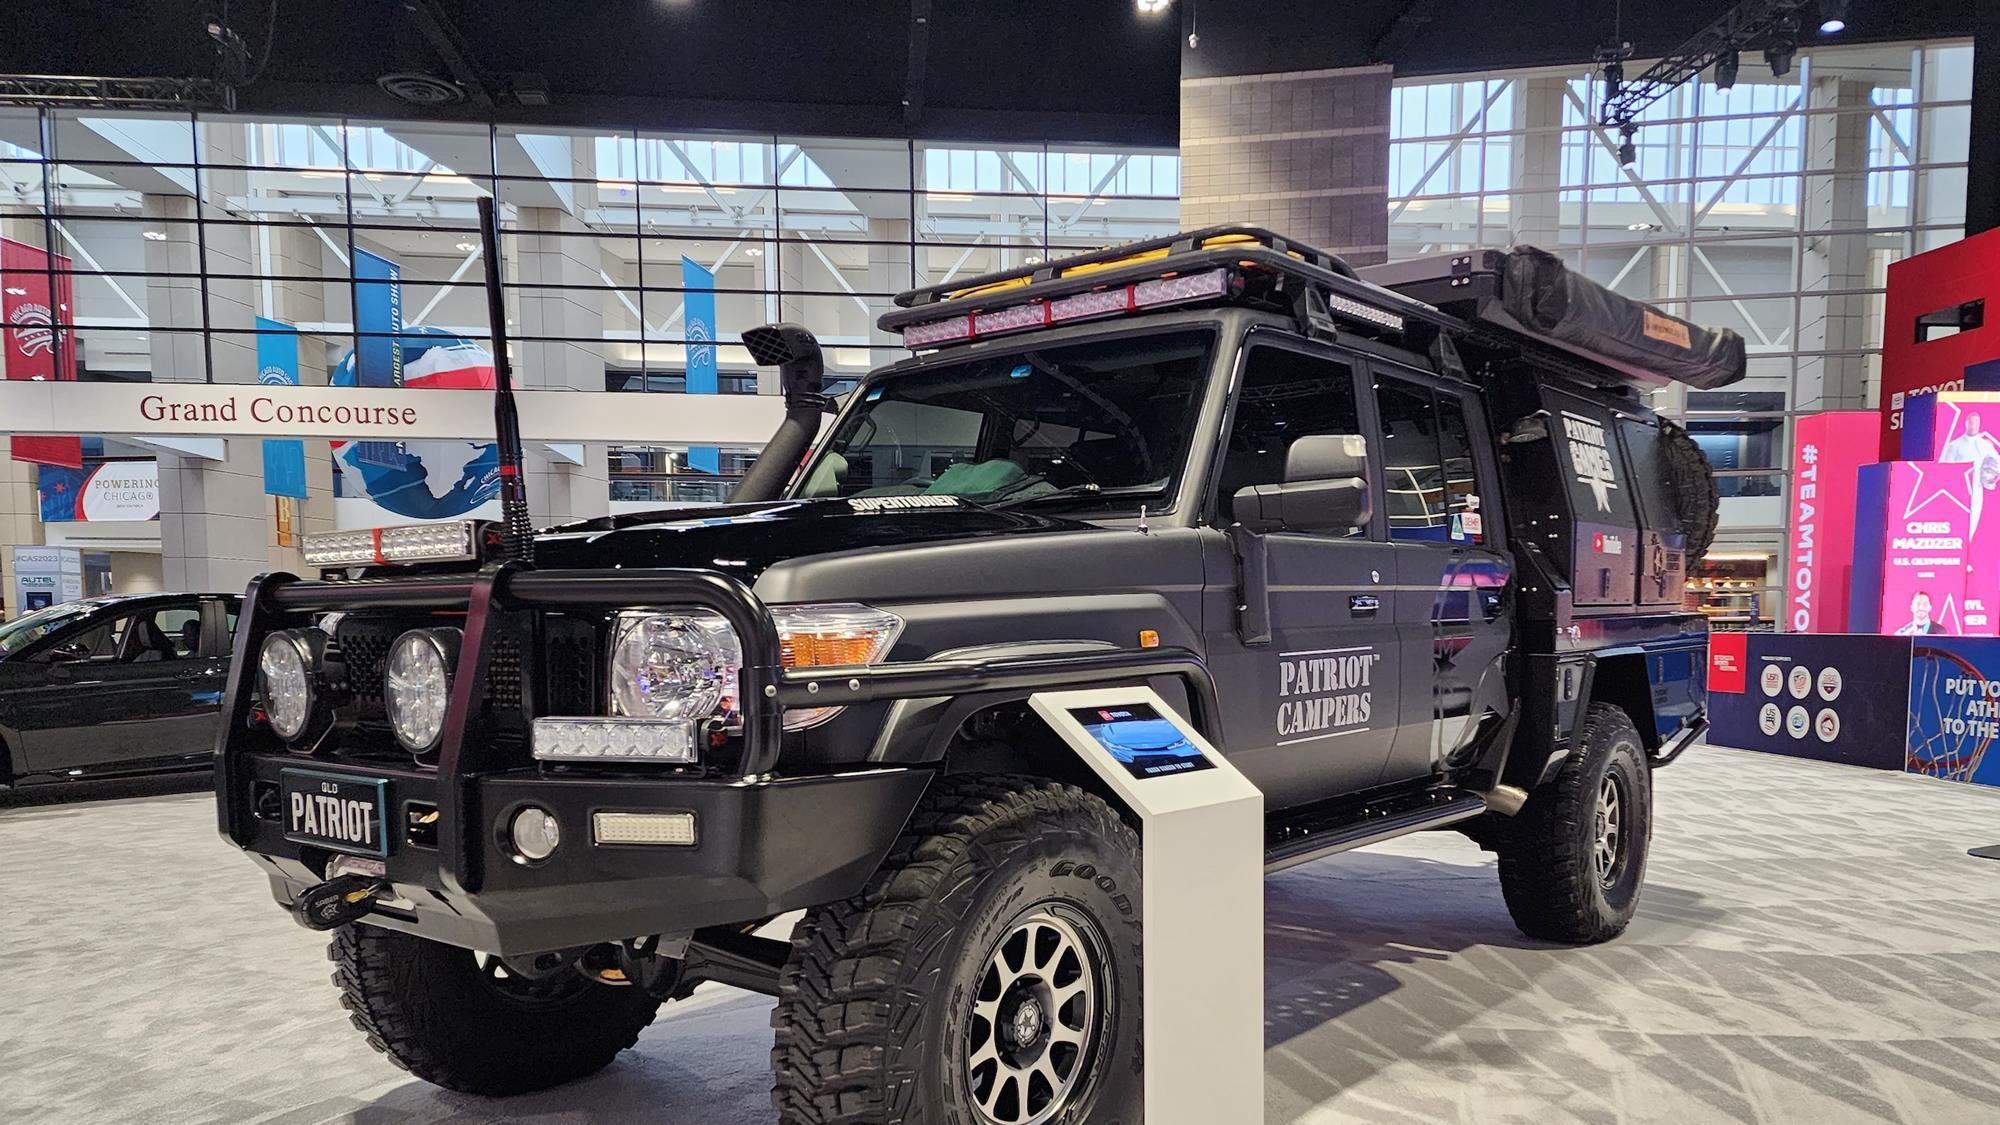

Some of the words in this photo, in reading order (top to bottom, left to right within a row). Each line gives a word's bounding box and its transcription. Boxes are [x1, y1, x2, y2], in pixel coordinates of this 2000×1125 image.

[10, 303, 33, 322] CHICAGO
[391, 307, 400, 337] UTO
[393, 339, 401, 386] ARGEST
[1908, 379, 1964, 397] YOT
[140, 396, 236, 421] Grand
[250, 397, 417, 425] Concourse
[481, 466, 500, 484] CHICA
[103, 491, 154, 501] CHICAGO
[848, 495, 960, 511] SUPERTOURER
[1907, 521, 1951, 534] CHRIS
[1794, 444, 1818, 633] #TEAMTOYO
[1280, 654, 1374, 697] PATRIOT
[1945, 678, 1977, 696] PUT
[1978, 680, 2000, 698] YO
[1276, 692, 1371, 736] CAMPERS
[1966, 700, 2000, 718] ATH
[1943, 717, 1966, 735] TO
[1967, 720, 2000, 739] THE
[291, 792, 373, 844] PATRIOT
